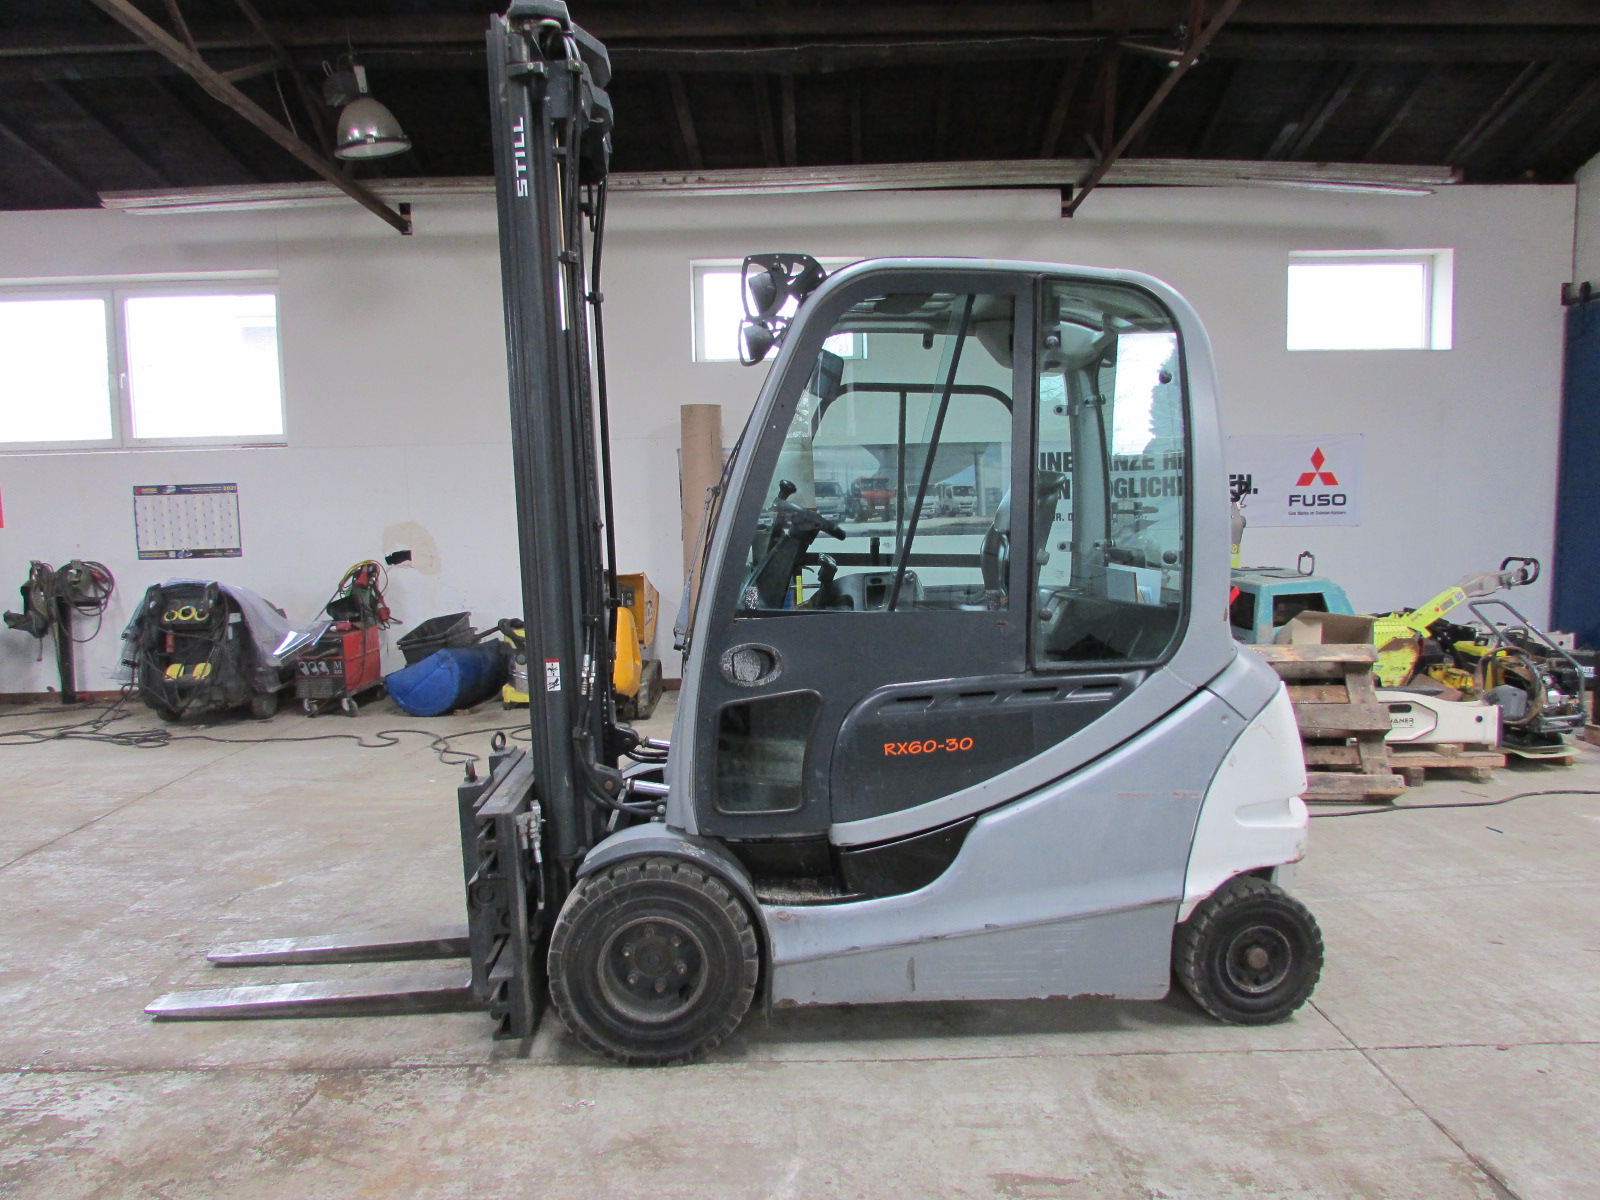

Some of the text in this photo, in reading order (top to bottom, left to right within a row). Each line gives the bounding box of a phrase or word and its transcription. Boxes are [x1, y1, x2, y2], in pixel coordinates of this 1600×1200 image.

[513, 116, 528, 197] STILL
[1039, 452, 1073, 472] INE
[1288, 493, 1347, 507] FUSO
[884, 737, 974, 755] RX60-30
